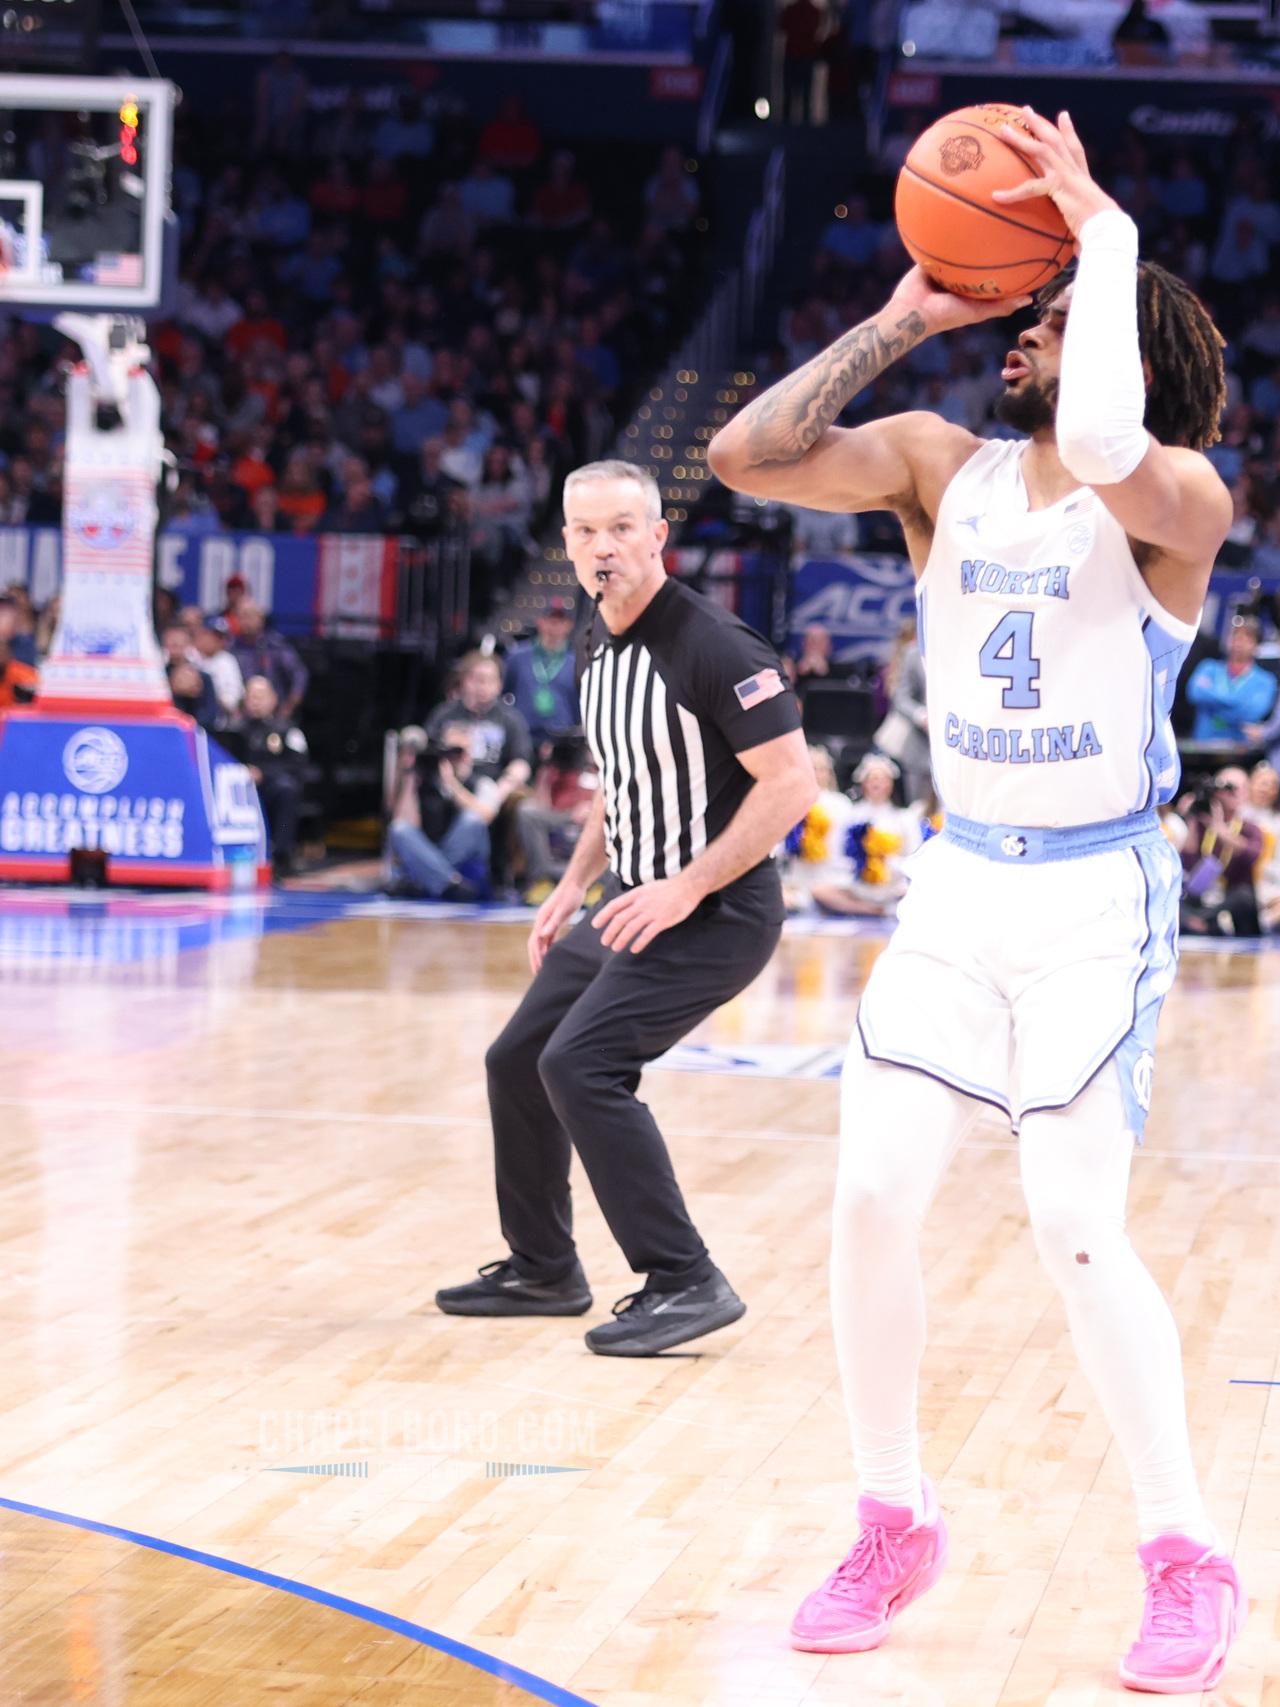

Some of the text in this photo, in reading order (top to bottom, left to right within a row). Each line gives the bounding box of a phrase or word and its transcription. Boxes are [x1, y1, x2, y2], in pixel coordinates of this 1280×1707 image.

[961, 560, 1070, 600] NORTH
[979, 610, 1041, 709] 4
[944, 712, 1102, 763] CAROLINA
[4, 791, 185, 824] ACCOMPLISH
[1, 815, 184, 857] GREATNESS
